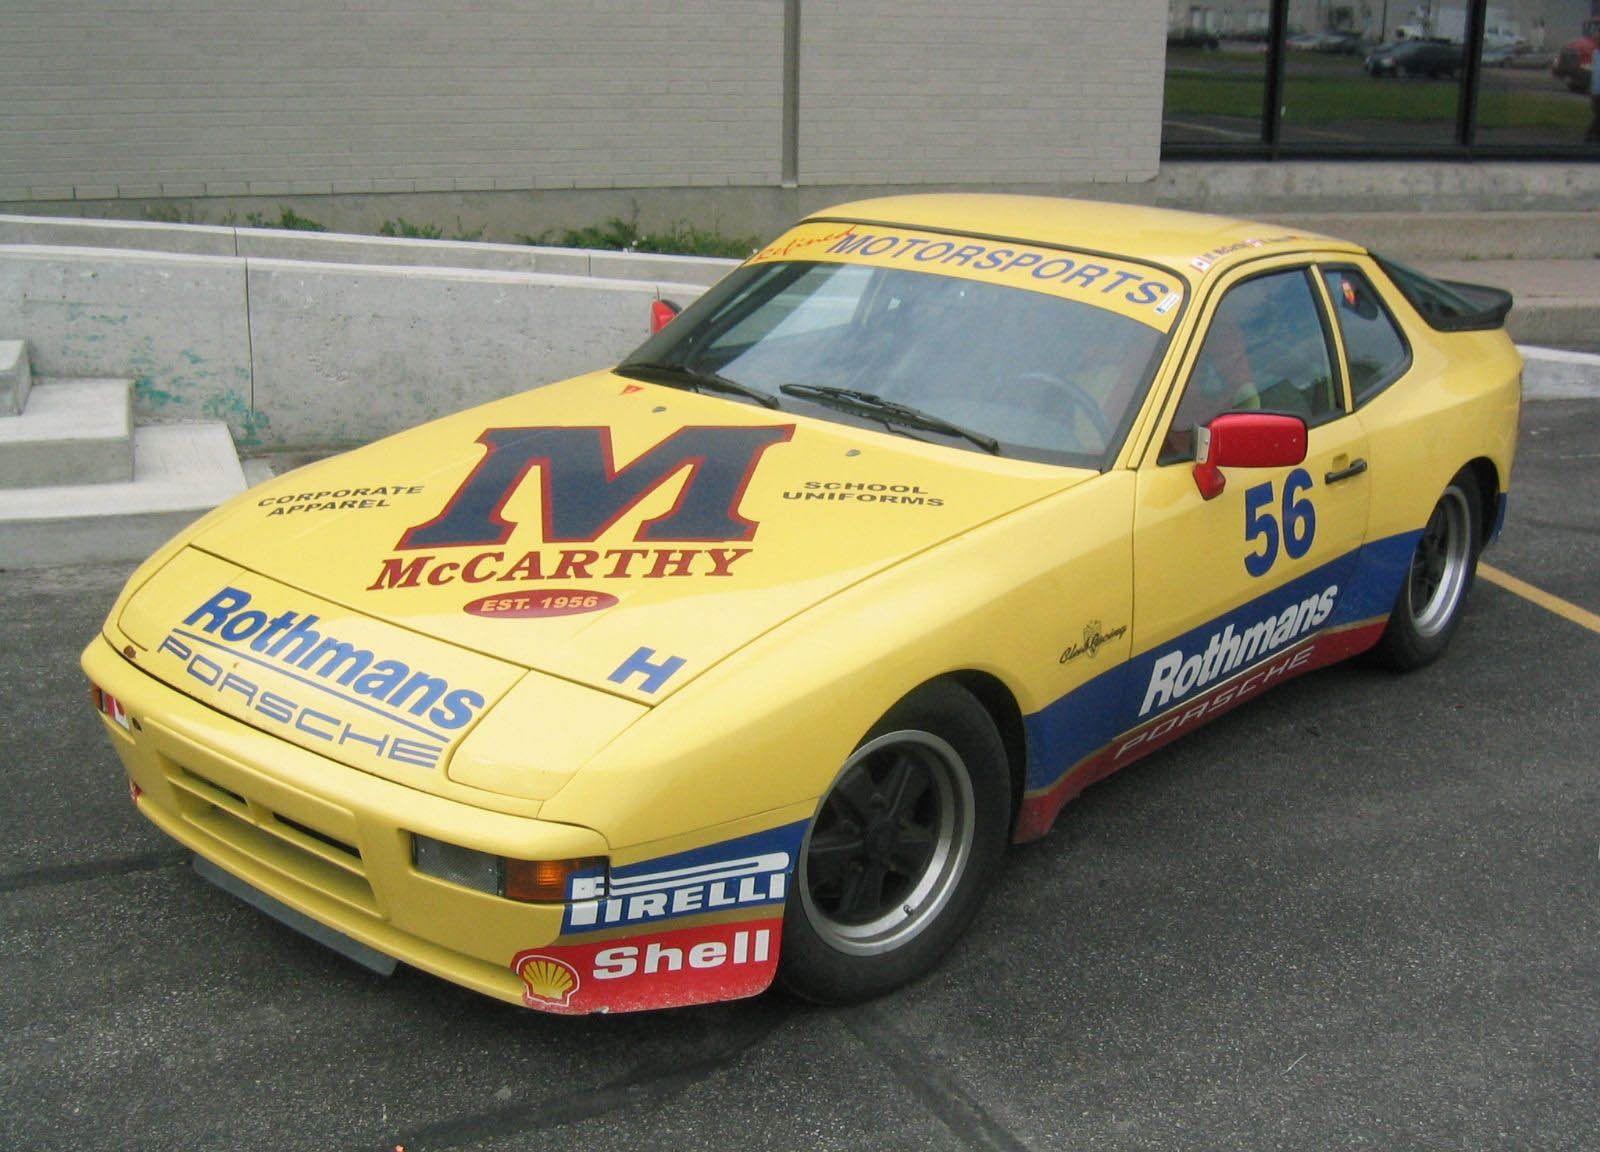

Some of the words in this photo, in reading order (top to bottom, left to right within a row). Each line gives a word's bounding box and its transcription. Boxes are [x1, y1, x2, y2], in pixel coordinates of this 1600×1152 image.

[825, 234, 1169, 304] MOTORSPORTS
[258, 485, 423, 507] CORPORATE
[266, 498, 391, 518] APPAREL
[394, 424, 796, 550] M
[782, 491, 945, 508] UNIFORMS
[803, 481, 929, 495] SCHOOL
[1244, 468, 1316, 577] 56
[366, 548, 754, 591] McCARTHY
[480, 597, 530, 613] EST.
[539, 594, 598, 611] 1956
[183, 586, 485, 731] Rothmans
[607, 646, 687, 694] H
[1138, 585, 1338, 717] Rothmans
[157, 635, 444, 769] PORSCHE
[1113, 645, 1315, 759] PORSCHE
[570, 852, 790, 926] PIRELLI
[592, 929, 770, 980] Shell
